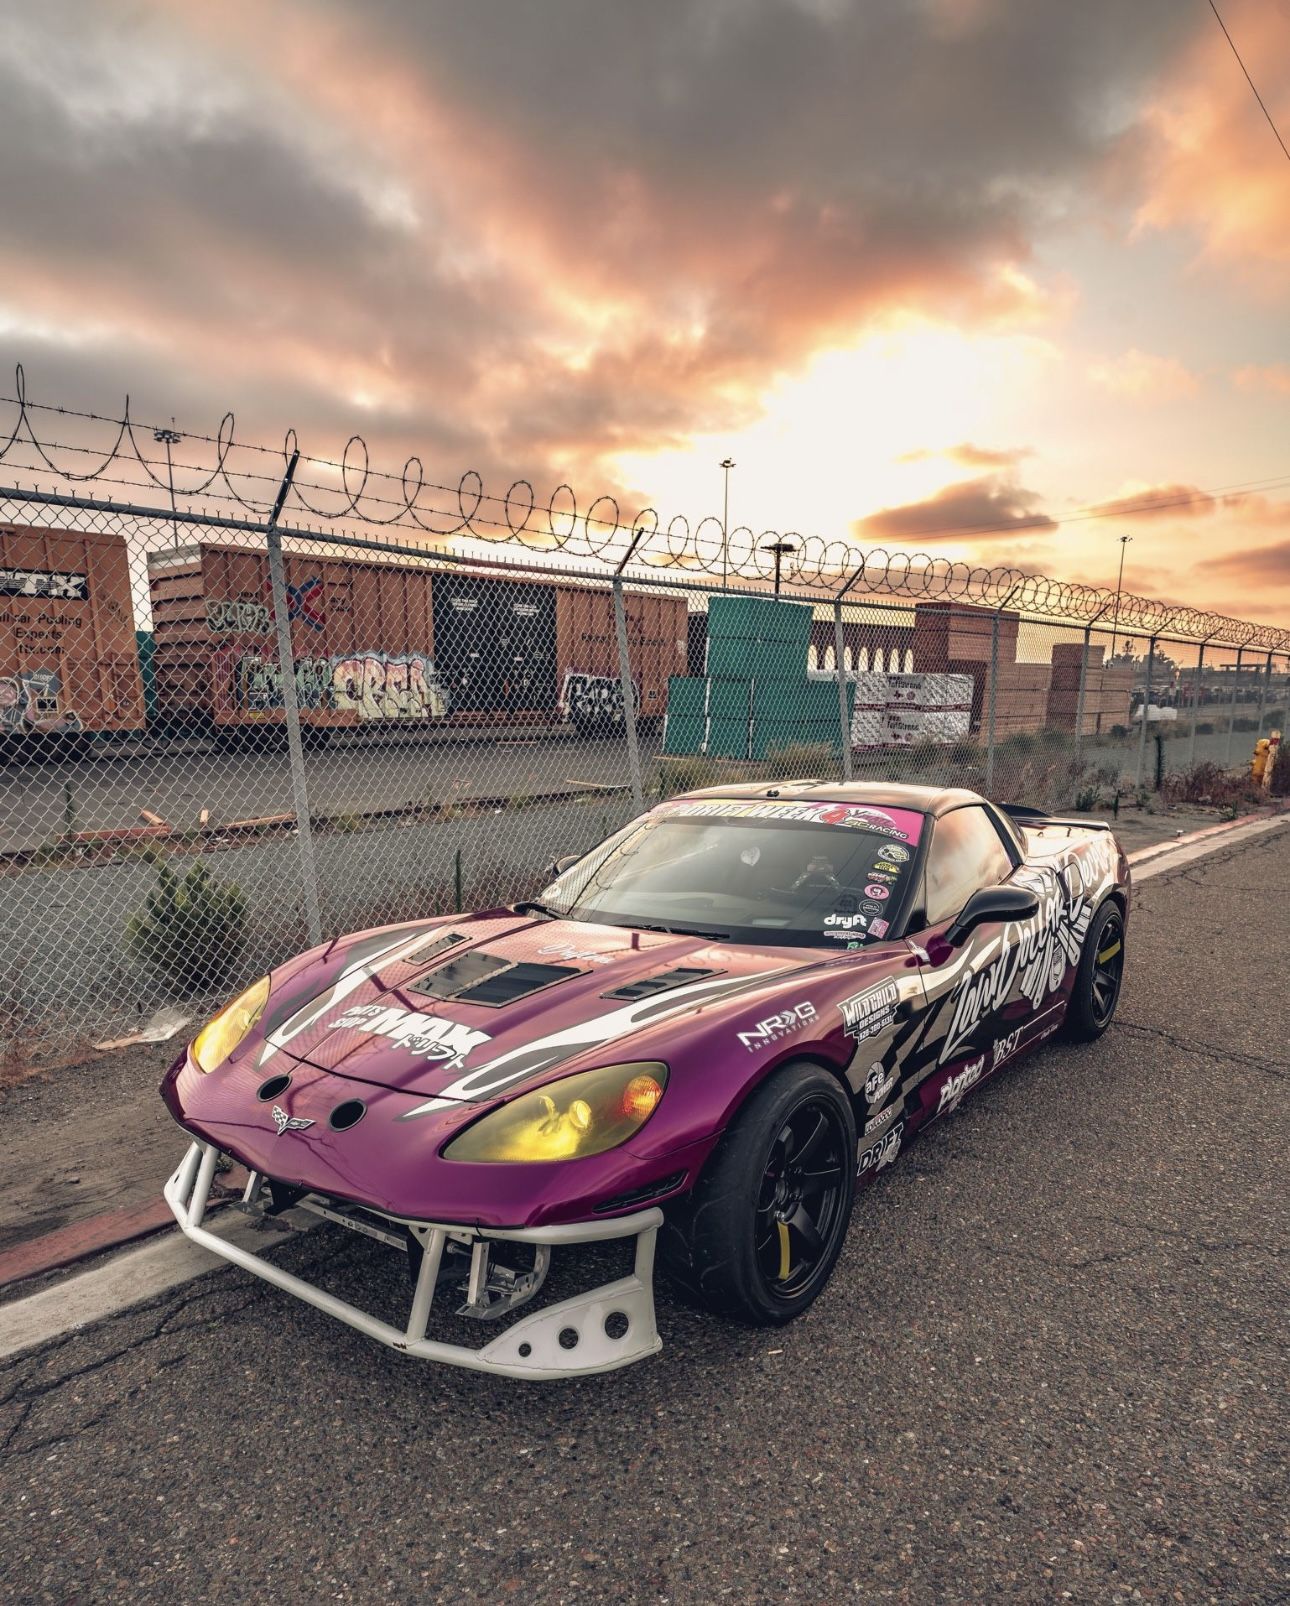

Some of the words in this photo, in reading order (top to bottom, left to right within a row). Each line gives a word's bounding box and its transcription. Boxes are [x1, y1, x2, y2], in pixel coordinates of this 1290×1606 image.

[749, 804, 822, 823] WEEK
[868, 824, 909, 839] RACING
[359, 1008, 493, 1056] MAX
[747, 1014, 820, 1053] INNOVATIONS
[866, 1072, 886, 1094] aFe
[857, 1121, 904, 1177] DRIFT
